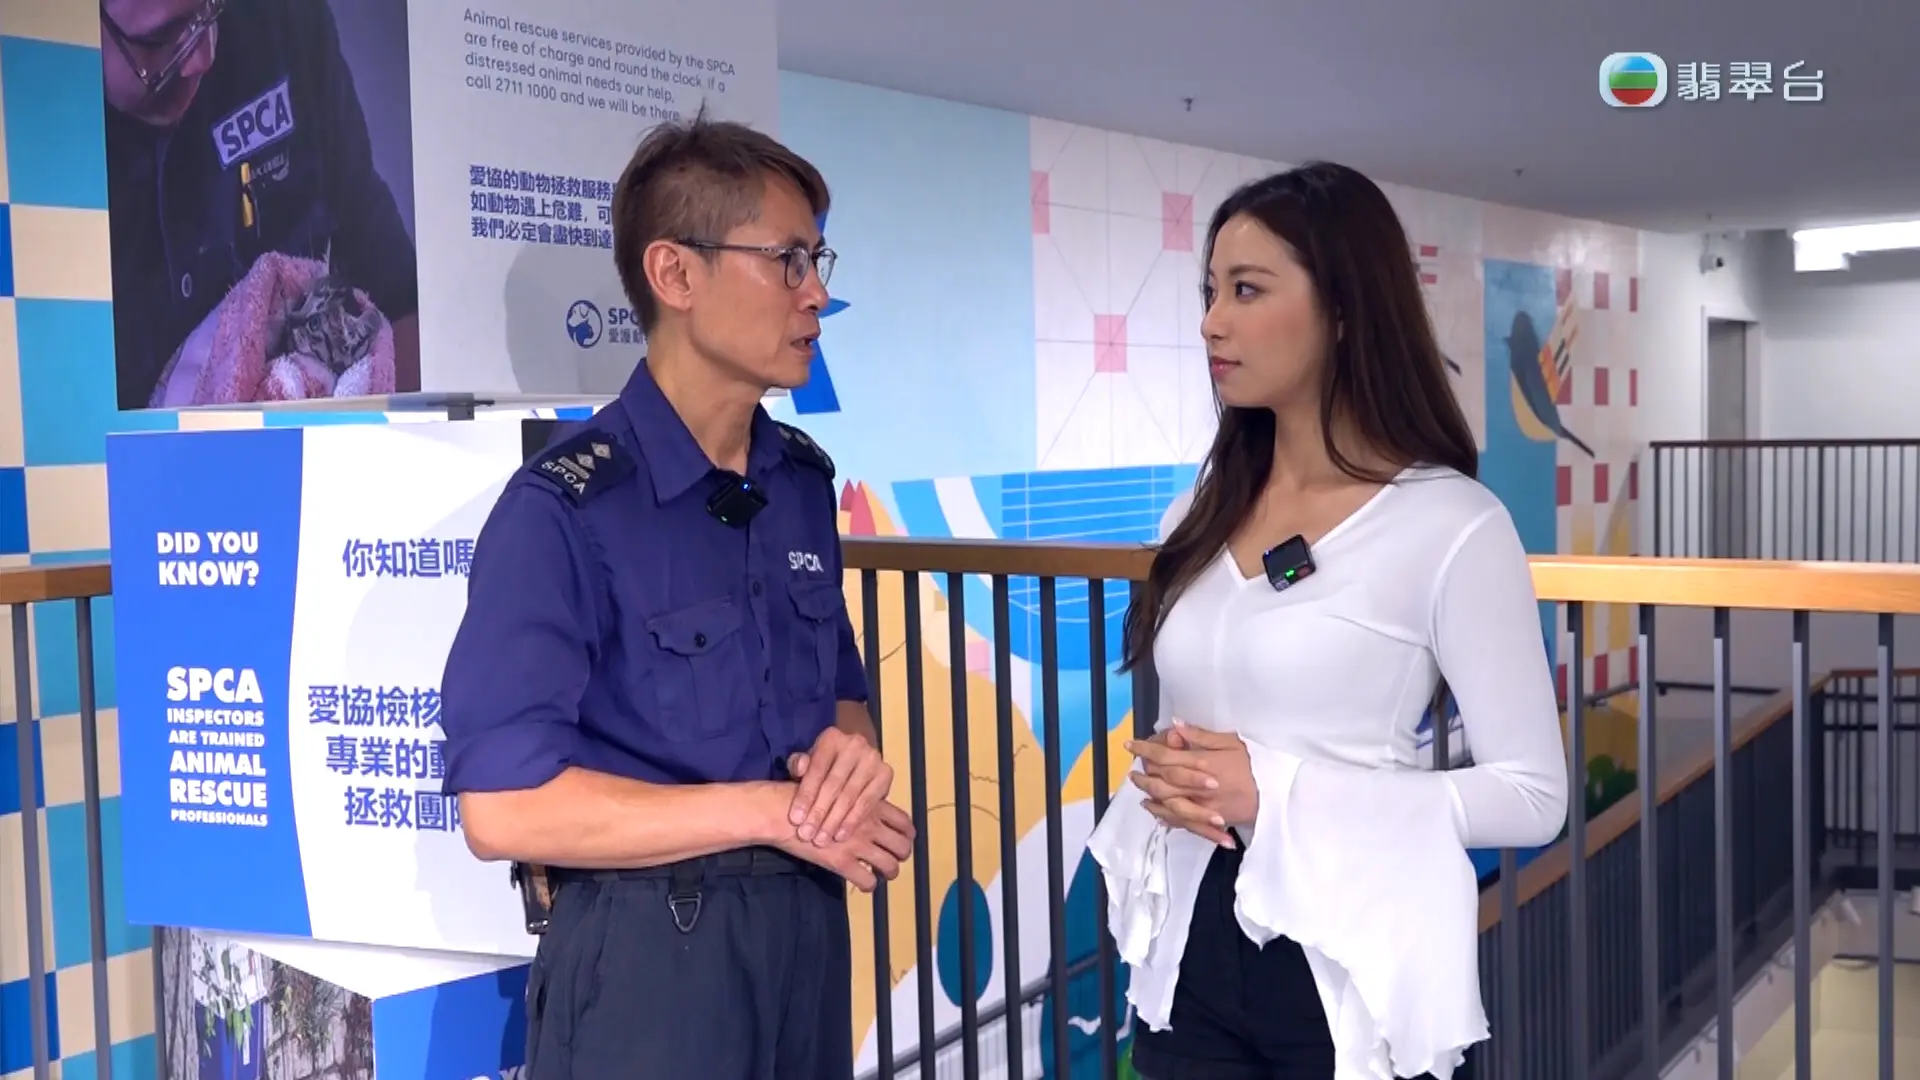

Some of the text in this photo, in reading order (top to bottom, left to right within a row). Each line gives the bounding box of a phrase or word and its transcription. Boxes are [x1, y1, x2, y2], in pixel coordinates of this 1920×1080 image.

[464, 8, 736, 76] Animal rescue services provided by the SPCA
[464, 32, 488, 47] are
[491, 34, 519, 53] free
[522, 41, 536, 56] of
[539, 46, 585, 67] charge
[587, 56, 611, 71] and
[614, 61, 648, 78] round
[651, 67, 670, 82] the
[718, 82, 726, 93] a
[465, 52, 536, 77] distressed
[539, 66, 583, 85] animal
[586, 75, 622, 93] needs
[625, 82, 645, 96] our
[465, 74, 492, 91] call
[495, 77, 524, 96] 2711
[527, 83, 557, 102] 1000
[560, 90, 585, 106] and
[588, 95, 606, 109] we
[609, 98, 629, 113] will
[632, 101, 647, 116] be
[221, 91, 291, 157] SPCA
[469, 164, 616, 202] 愛協的動物拯救服務
[471, 216, 612, 250] 我們必定會盡快到達
[541, 461, 586, 495] SPCA
[157, 531, 259, 554] DID YOU
[342, 538, 475, 578] 你知道嗎
[158, 560, 260, 586] KNOW?
[788, 551, 824, 573] SPCA
[166, 666, 264, 703] SPCA
[166, 708, 265, 727] INSPECTORS
[307, 685, 442, 729] 愛協檢核
[168, 730, 265, 748] ARE TRAINED
[169, 750, 266, 777] ANIMAL
[169, 778, 268, 808] RESCUE
[170, 808, 268, 828] PROFESSIONALS
